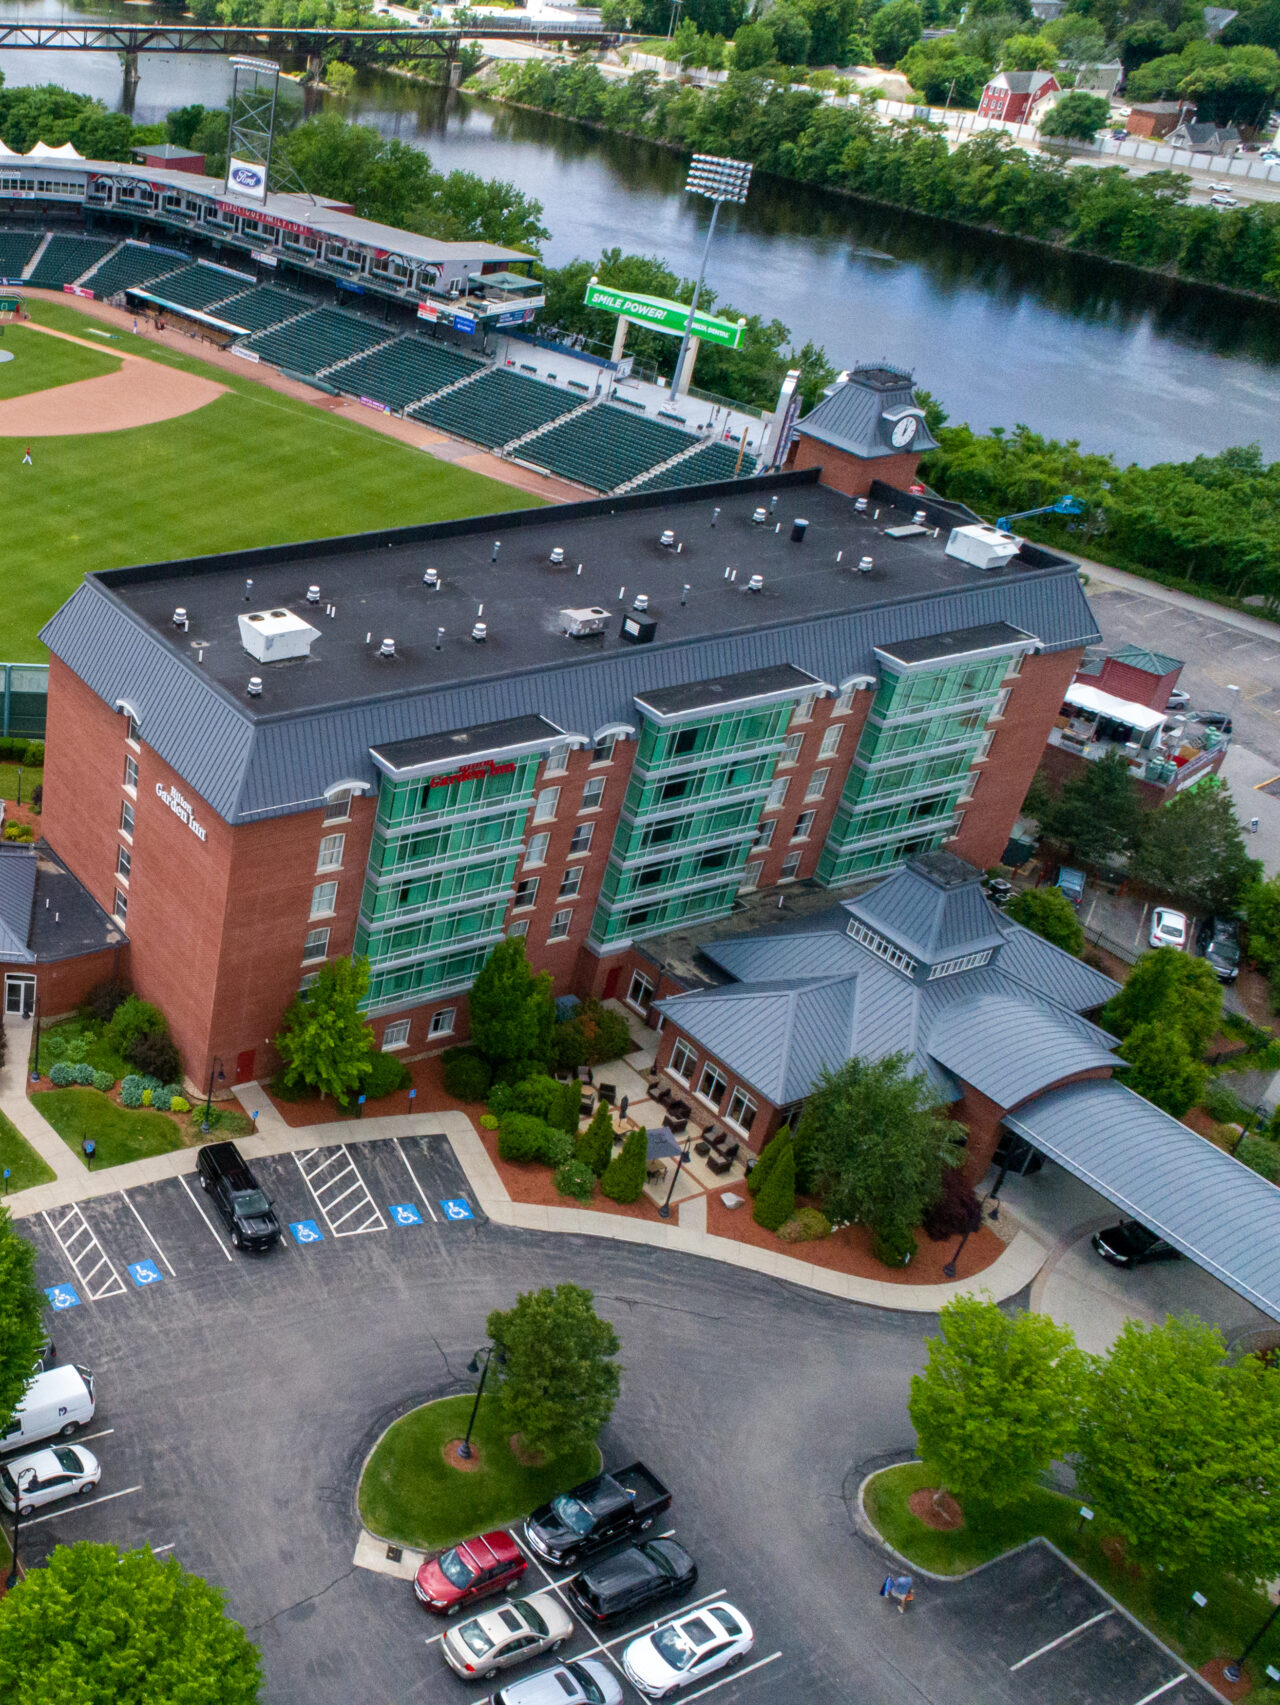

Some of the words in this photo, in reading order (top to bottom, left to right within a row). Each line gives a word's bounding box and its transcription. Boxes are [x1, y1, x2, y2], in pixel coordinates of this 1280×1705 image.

[236, 170, 257, 186] Ford
[591, 293, 623, 309] SMILE
[622, 300, 668, 320] POWER!
[429, 769, 486, 788] Garden
[490, 762, 515, 776] Inn
[155, 783, 188, 824] Garden
[188, 814, 207, 842] Inn
[170, 786, 193, 815] Hilton
